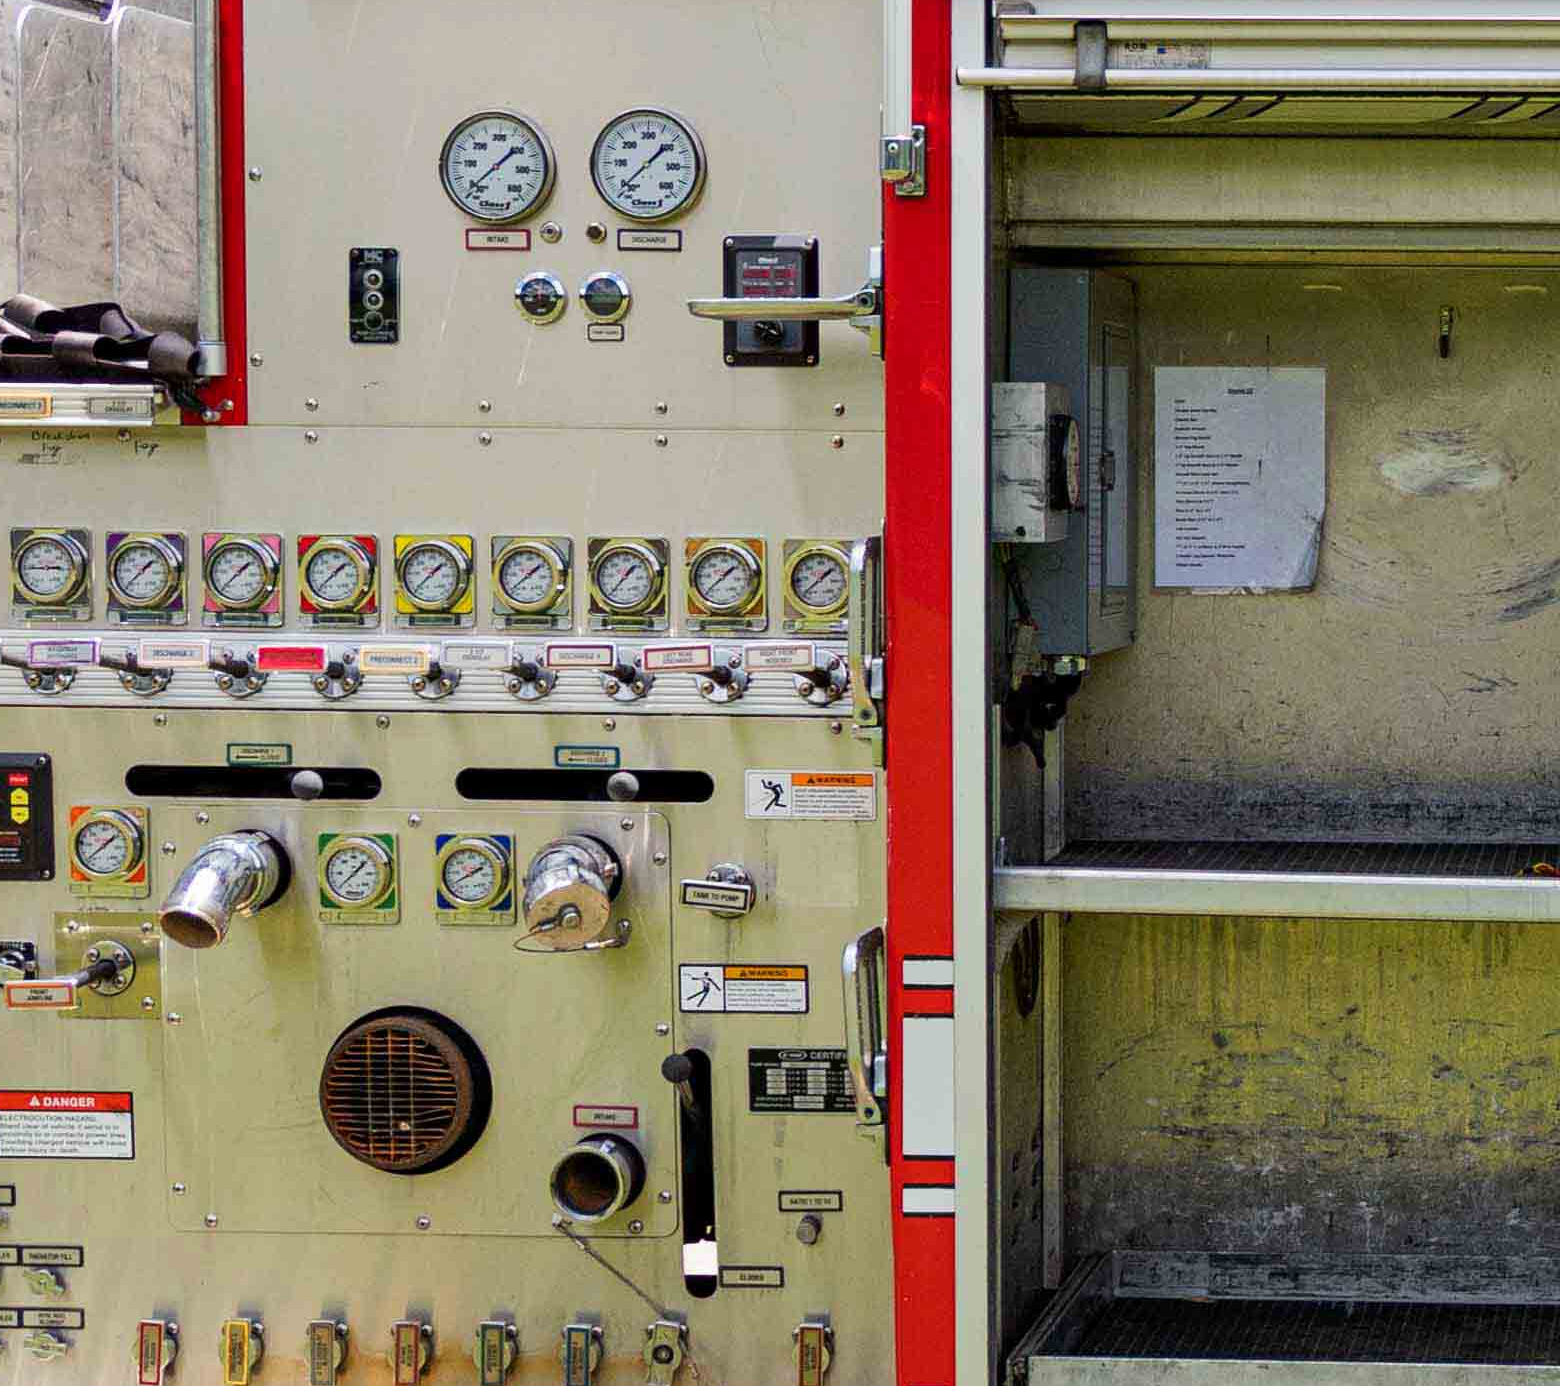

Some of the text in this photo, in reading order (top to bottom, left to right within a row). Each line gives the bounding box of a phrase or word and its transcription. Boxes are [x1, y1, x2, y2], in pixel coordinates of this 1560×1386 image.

[492, 133, 507, 142] 300
[641, 131, 657, 140] 300
[473, 141, 488, 151] 200
[622, 140, 638, 150] 200
[464, 159, 477, 168] 100
[614, 158, 628, 167] 100
[666, 162, 680, 172] 500
[515, 165, 530, 174] 500
[507, 183, 522, 193] 600
[659, 181, 674, 190] 600
[486, 235, 509, 243] INTAKE
[631, 236, 667, 244] DISCHARGE
[692, 890, 709, 899] TANK
[720, 893, 740, 902] PUMP
[43, 1096, 96, 1108] DANGER
